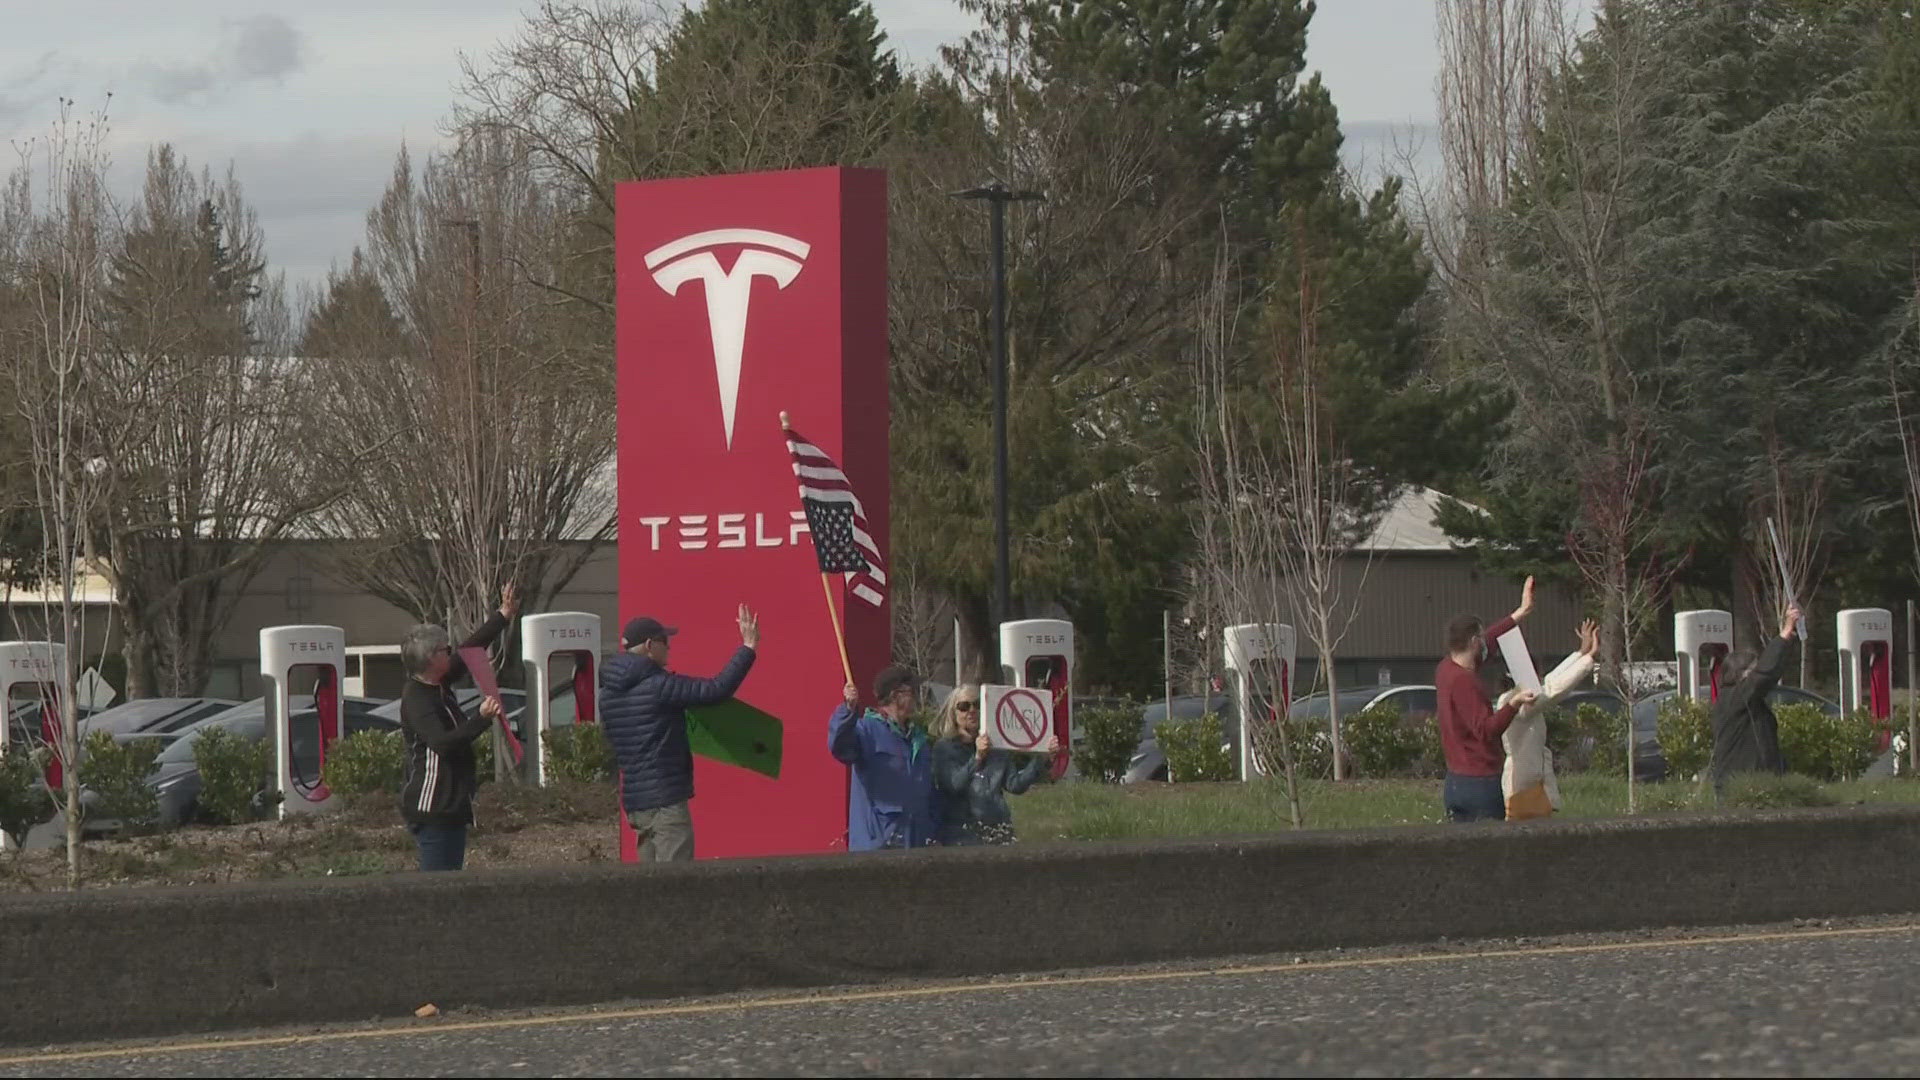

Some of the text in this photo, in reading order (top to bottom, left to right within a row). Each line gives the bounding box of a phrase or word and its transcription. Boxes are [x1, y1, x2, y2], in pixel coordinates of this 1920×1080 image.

[549, 628, 592, 638] TESLA
[1026, 634, 1065, 644] TESLA
[288, 642, 334, 651] TESLA
